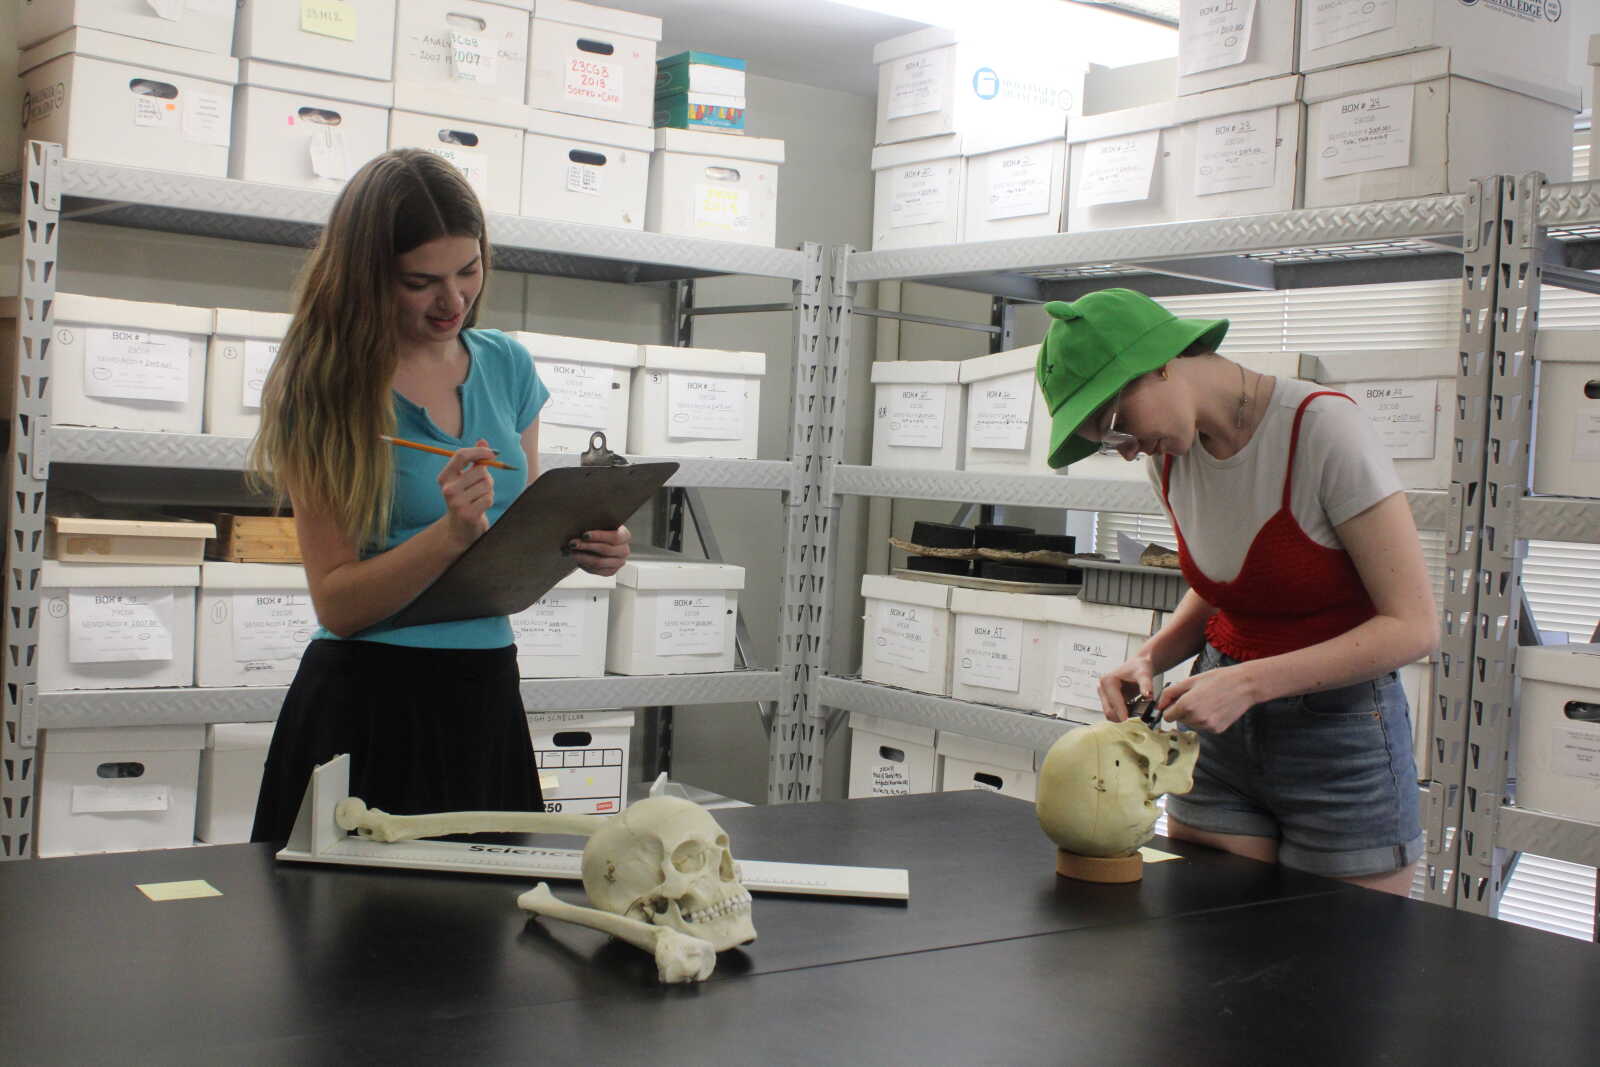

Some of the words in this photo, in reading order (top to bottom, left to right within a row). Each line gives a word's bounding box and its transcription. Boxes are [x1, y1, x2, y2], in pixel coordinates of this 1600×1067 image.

[112, 331, 133, 342] BOX
[1366, 388, 1386, 400] BOX
[95, 596, 116, 606] BOX
[256, 596, 275, 606] BOX
[673, 599, 689, 608] BOX
[467, 844, 584, 858] Science
